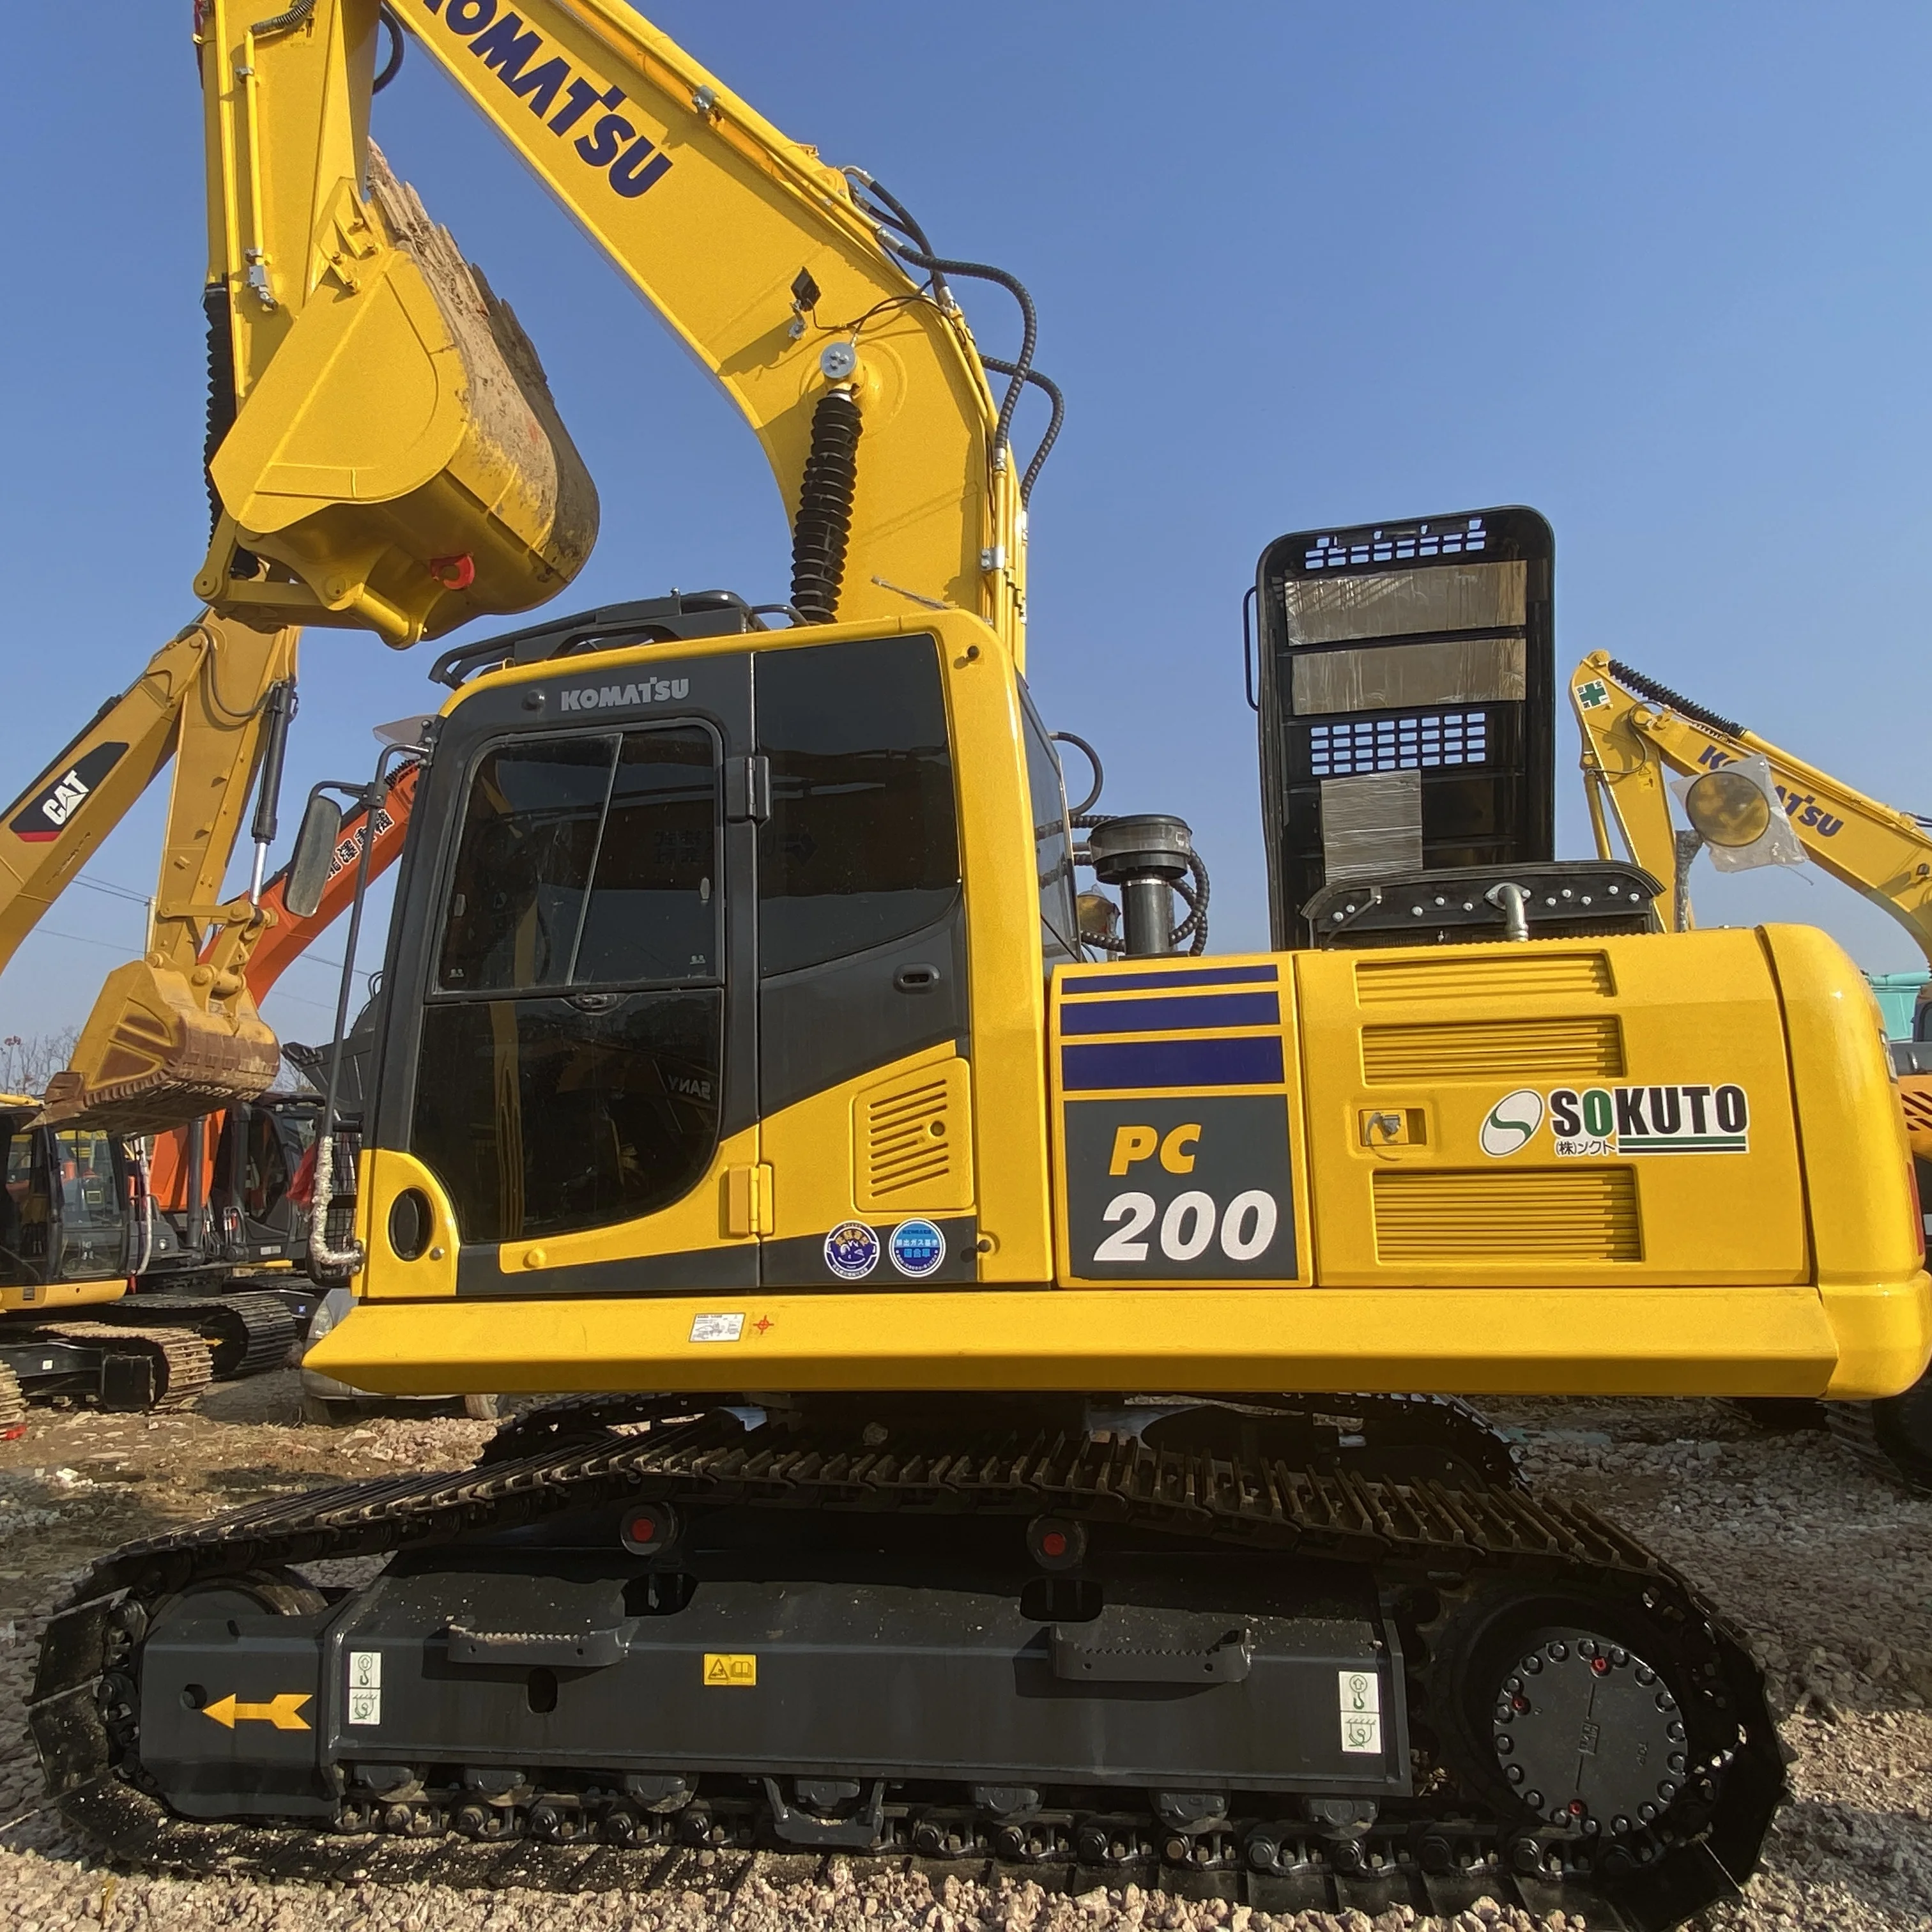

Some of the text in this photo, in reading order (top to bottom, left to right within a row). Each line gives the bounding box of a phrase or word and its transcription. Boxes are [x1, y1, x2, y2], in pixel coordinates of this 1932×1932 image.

[423, 0, 673, 198] OMATSU
[560, 677, 689, 711] KOMATSU
[42, 770, 89, 825] CAT
[1697, 745, 1844, 837] KTSU
[1551, 1085, 1747, 1137] SOKUTO
[1109, 1124, 1202, 1176] PC
[1093, 1190, 1277, 1261] 200
